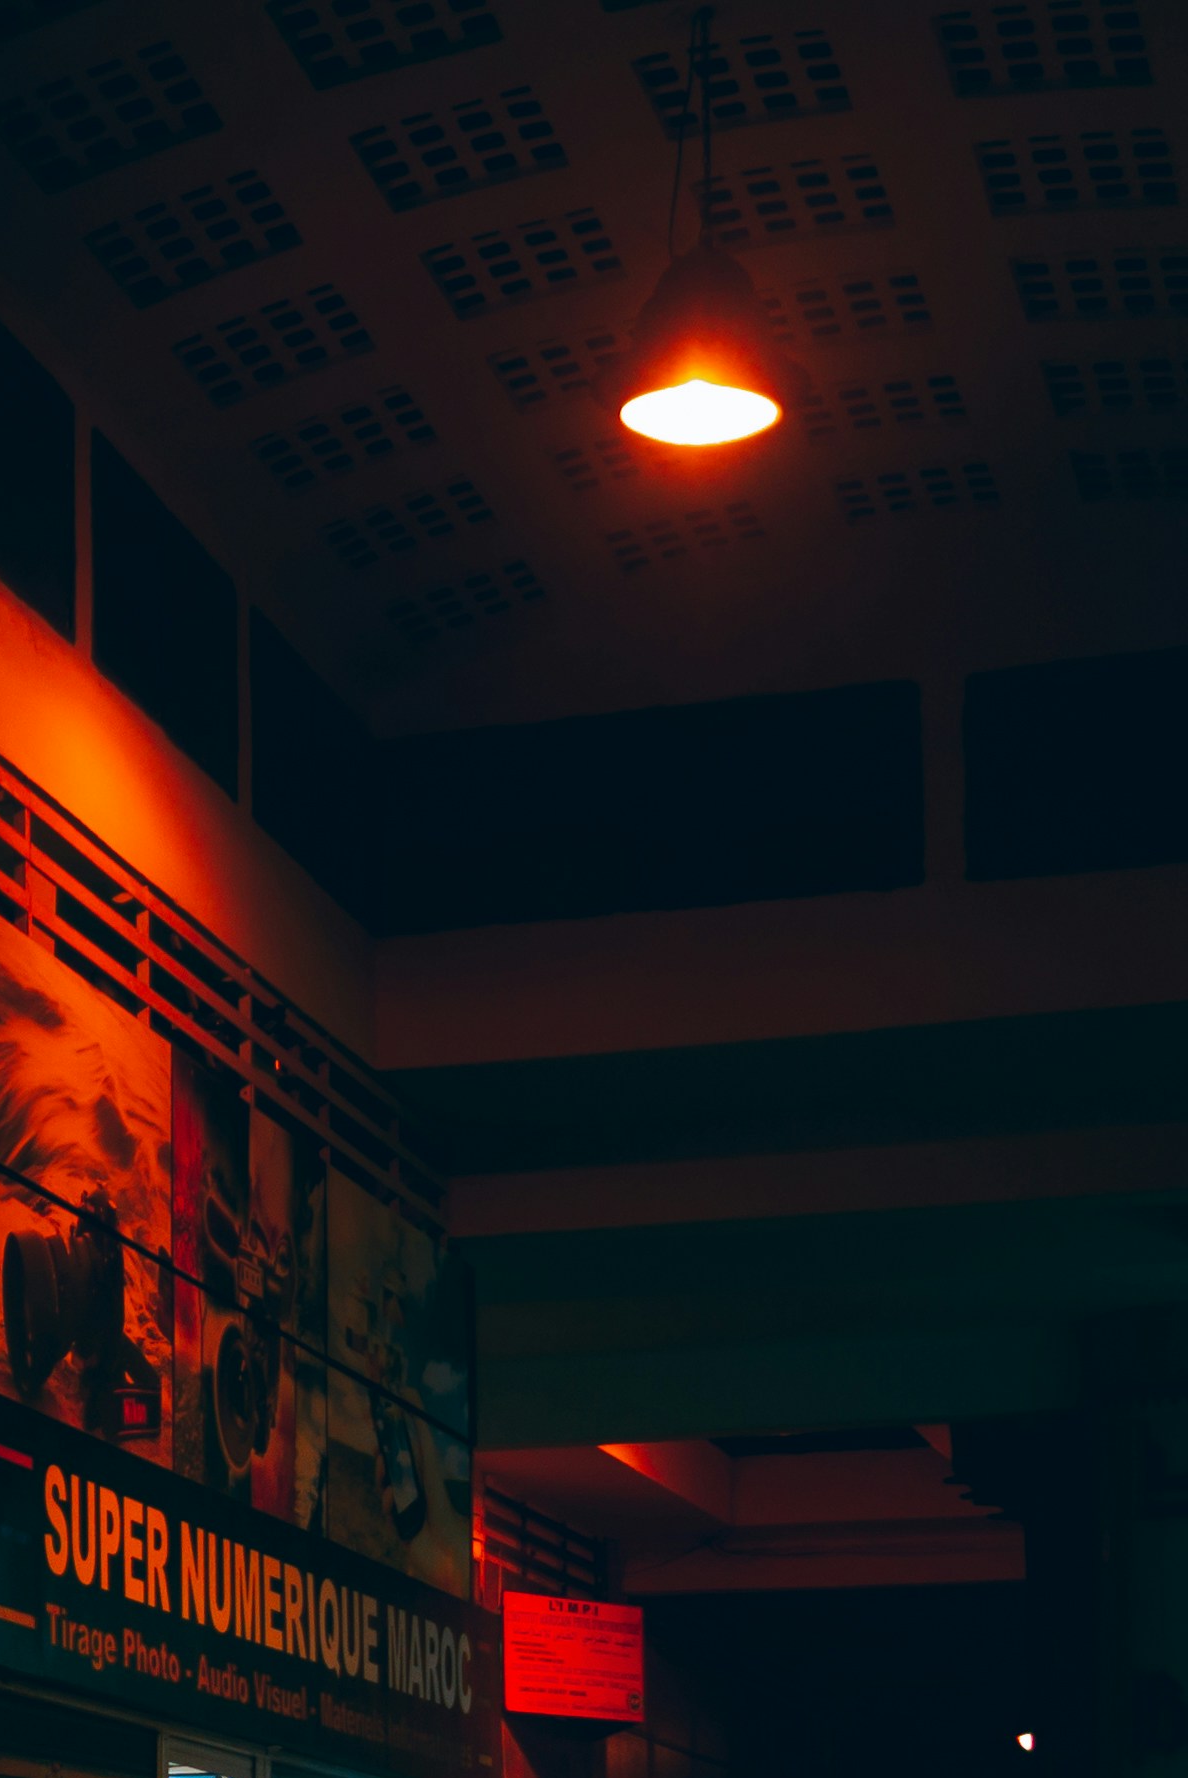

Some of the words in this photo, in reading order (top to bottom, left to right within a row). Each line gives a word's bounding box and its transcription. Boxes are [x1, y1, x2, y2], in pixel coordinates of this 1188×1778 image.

[44, 1464, 170, 1612] SUPER
[181, 1520, 380, 1684] NUMERIQUE
[387, 1603, 472, 1714] MAROC
[46, 1602, 116, 1671] Tirage
[123, 1627, 180, 1684] Photo
[196, 1654, 249, 1704] Audio
[253, 1668, 308, 1722] Visuel
